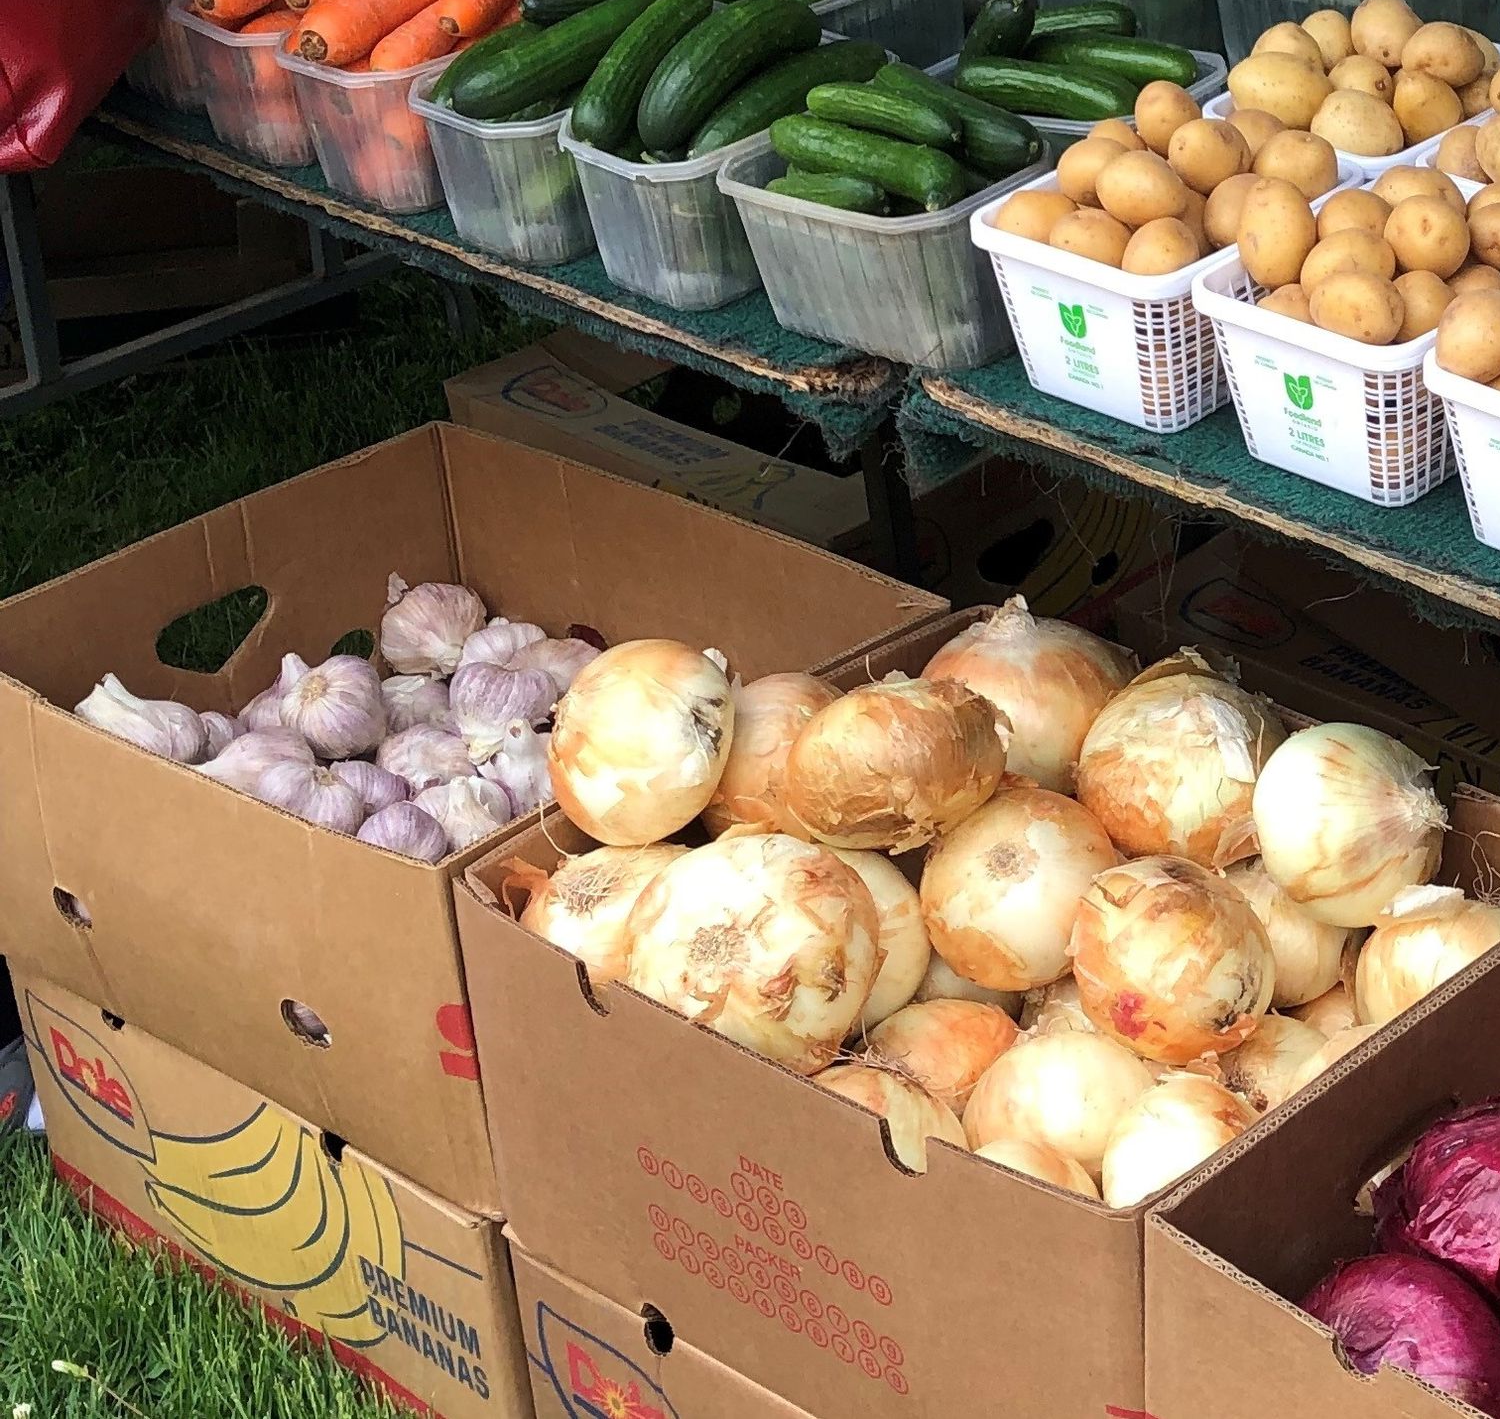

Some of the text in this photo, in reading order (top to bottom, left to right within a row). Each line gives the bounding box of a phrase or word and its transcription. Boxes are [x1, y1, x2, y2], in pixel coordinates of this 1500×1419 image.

[1288, 427, 1296, 437] 2
[49, 1025, 134, 1120] Dole
[739, 1154, 784, 1191] DATE
[734, 1233, 801, 1281] PACKER
[359, 1255, 482, 1361] PREMIUM
[367, 1294, 490, 1401] BANANAS
